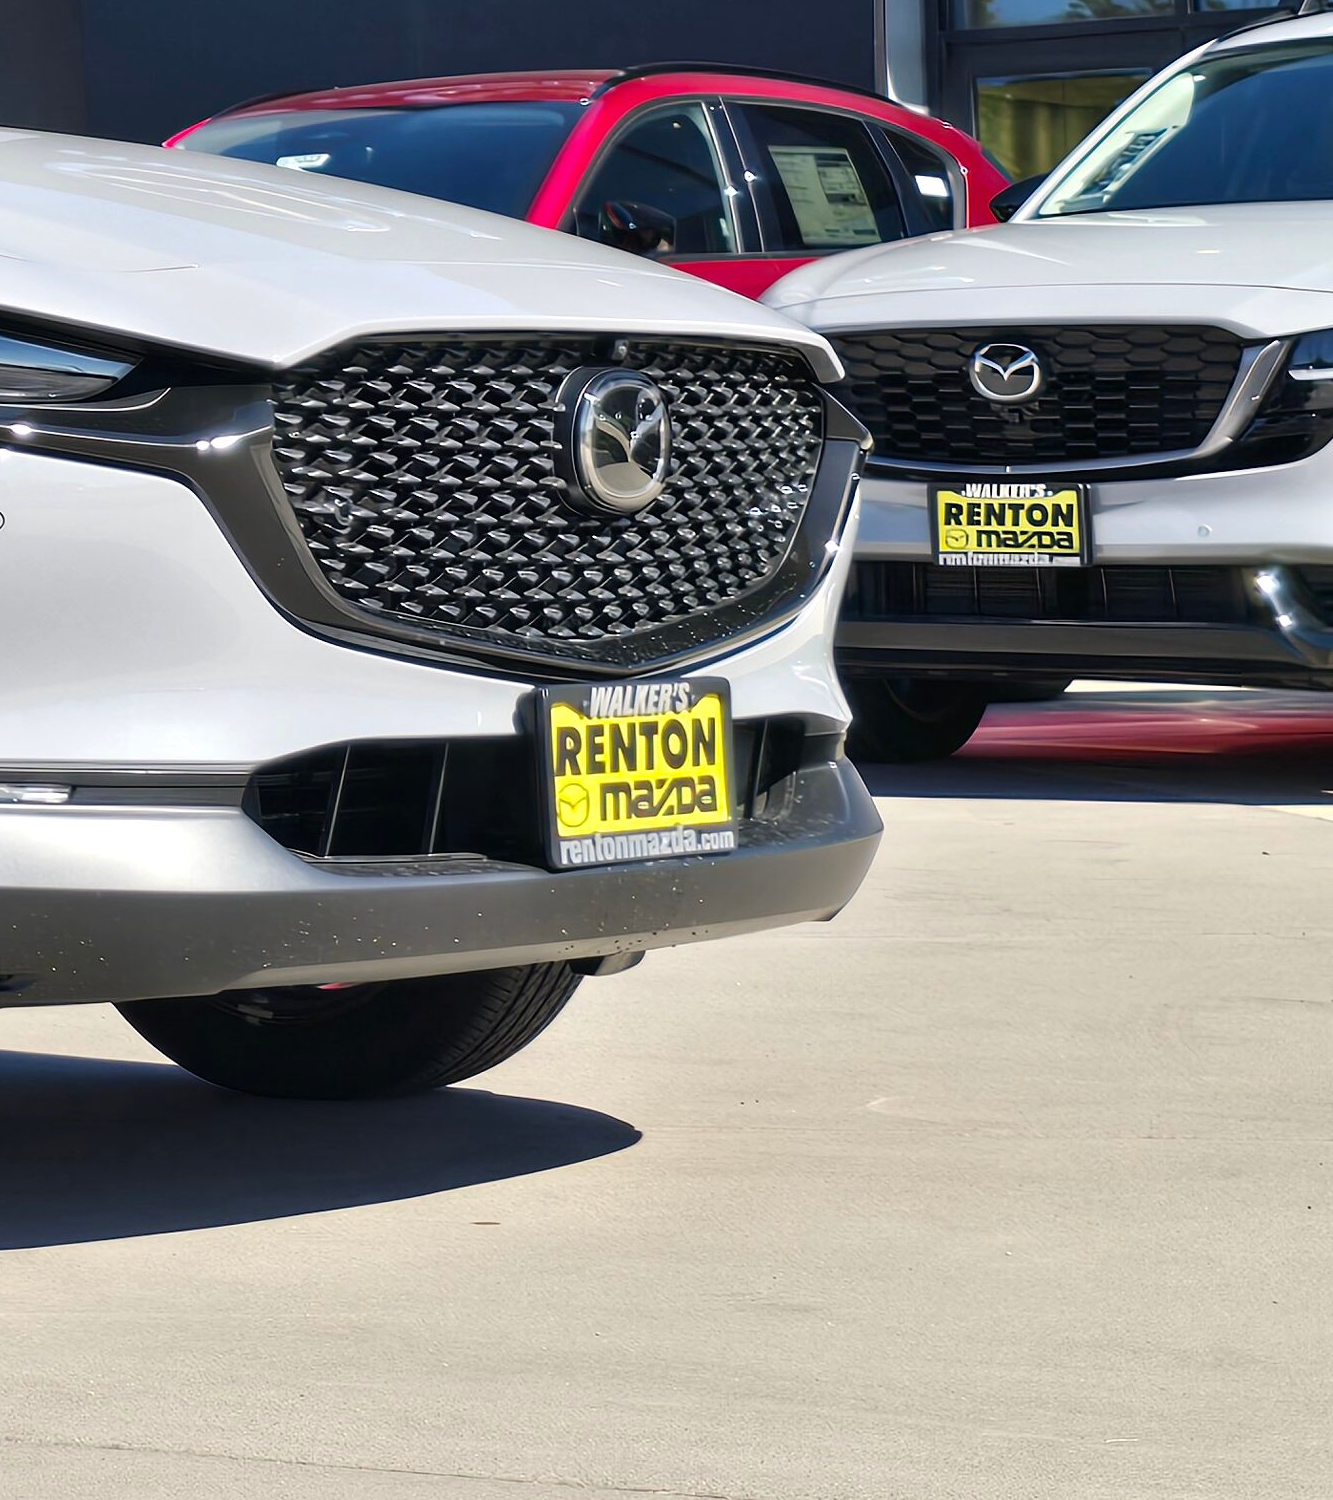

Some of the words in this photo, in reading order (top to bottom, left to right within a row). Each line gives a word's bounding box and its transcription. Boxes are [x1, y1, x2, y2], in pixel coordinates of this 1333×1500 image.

[944, 502, 1074, 527] RENTON
[976, 529, 1074, 549] mazda
[589, 682, 691, 719] WALKER'S
[555, 717, 716, 777] RENTON
[599, 775, 718, 822] mazda
[560, 826, 734, 865] rentonmazda.com
